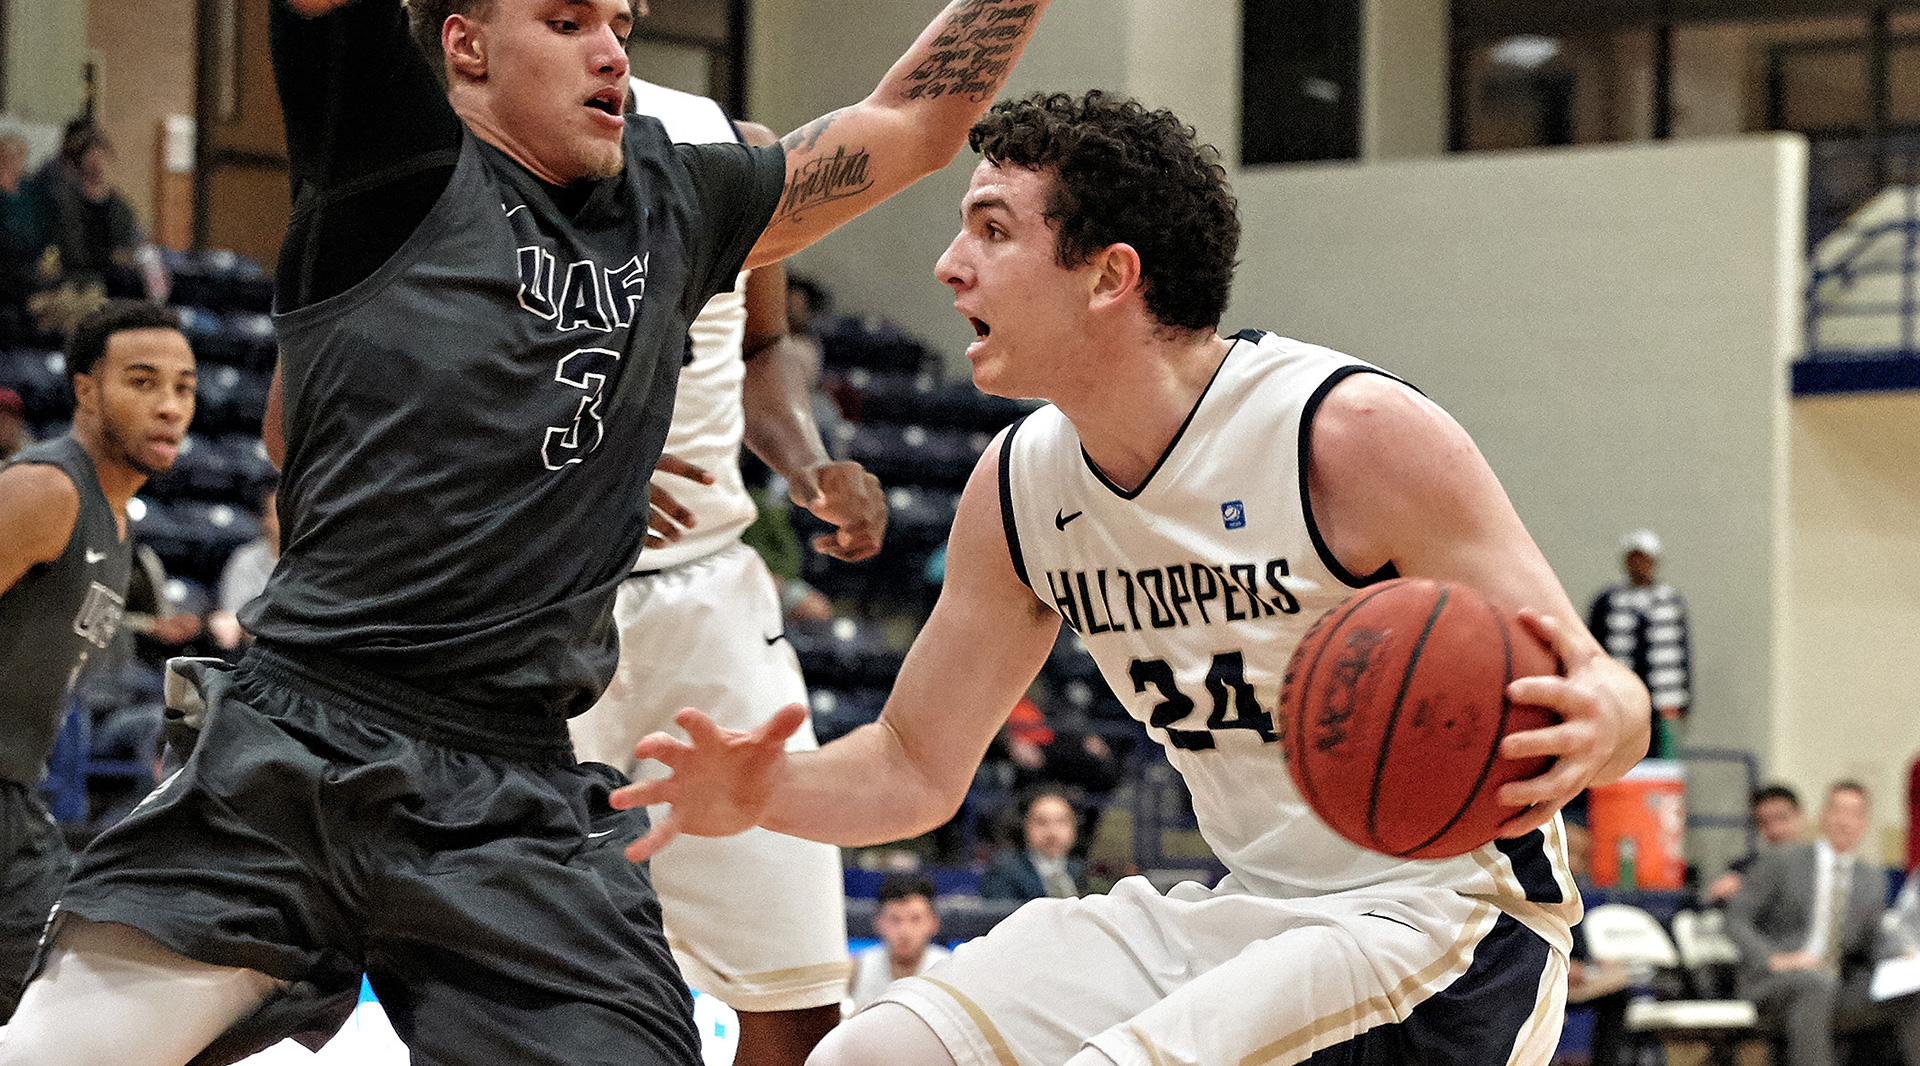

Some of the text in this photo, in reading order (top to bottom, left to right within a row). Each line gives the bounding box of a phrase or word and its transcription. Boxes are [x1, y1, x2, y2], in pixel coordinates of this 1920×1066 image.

[779, 146, 872, 216] hristina
[517, 246, 650, 332] UAF
[541, 348, 621, 470] 3
[1046, 559, 1301, 635] HLLTOPPERS
[1126, 650, 1280, 751] 24
